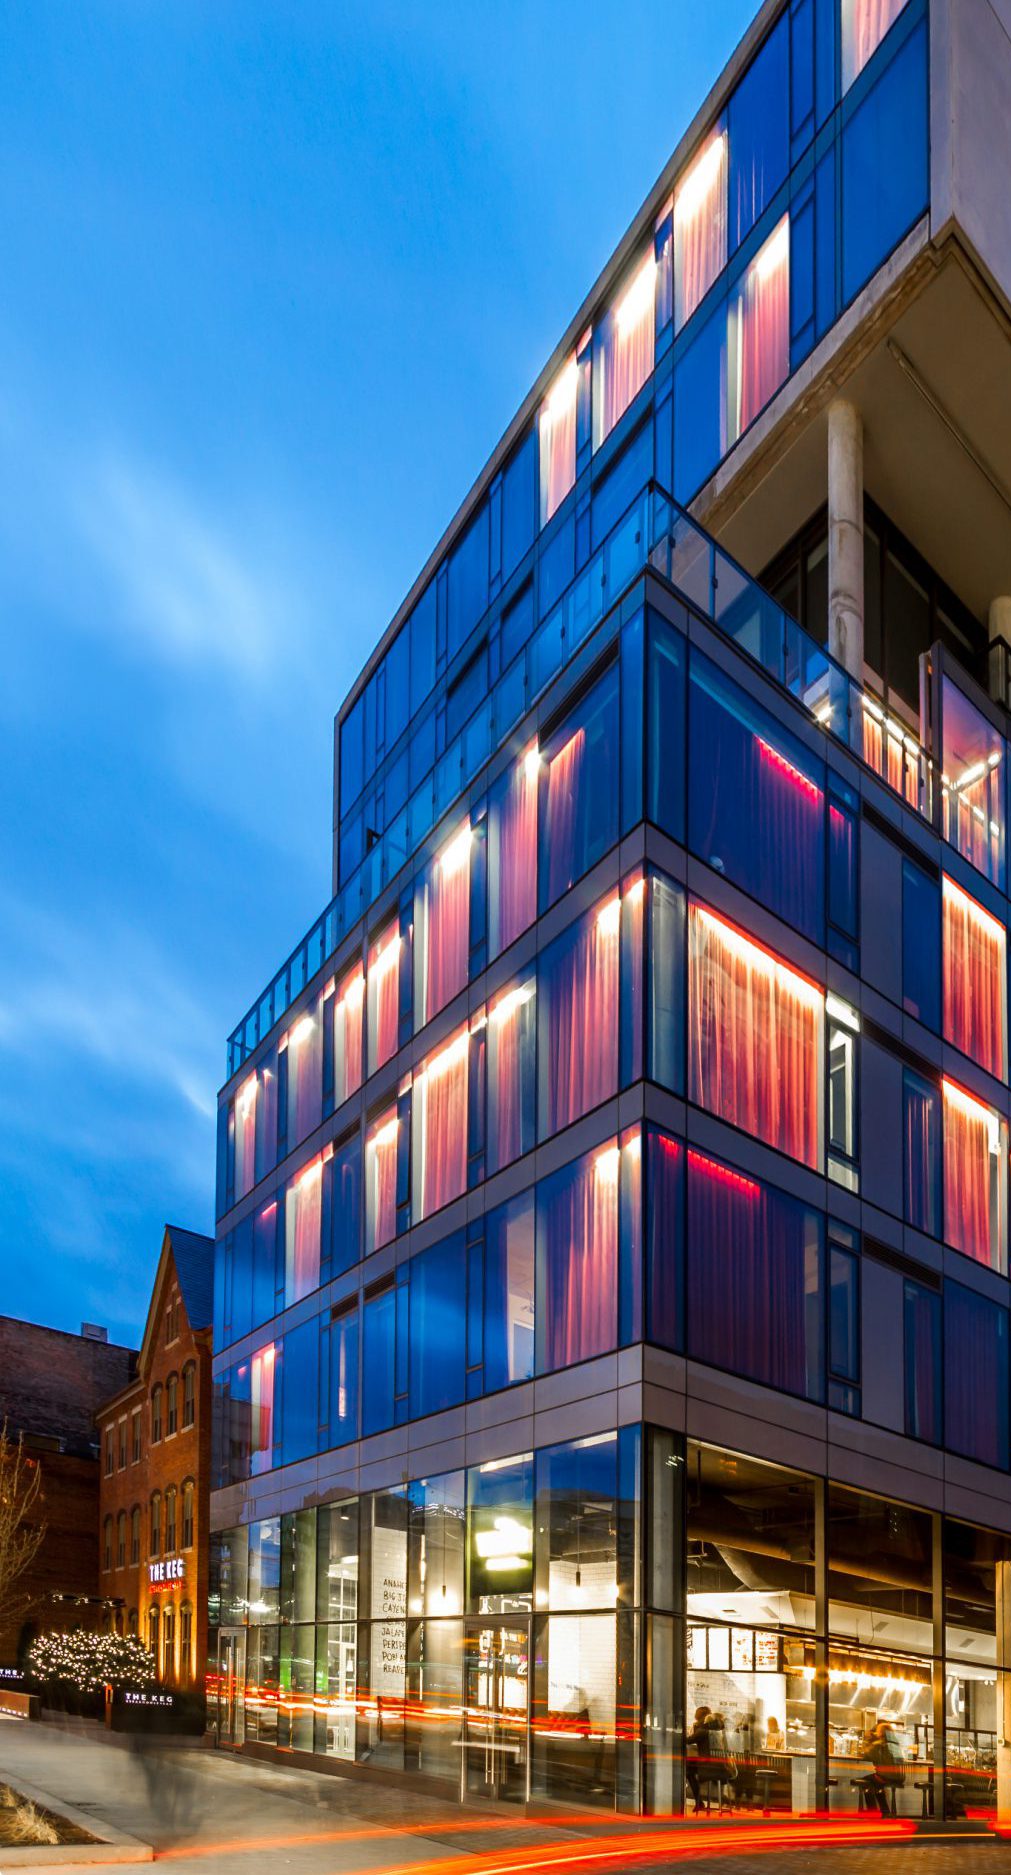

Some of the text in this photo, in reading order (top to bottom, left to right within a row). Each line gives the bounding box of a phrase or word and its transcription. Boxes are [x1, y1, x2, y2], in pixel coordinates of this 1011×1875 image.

[150, 1559, 184, 1582] THE KEG
[383, 1591, 396, 1601] BIG
[125, 1693, 147, 1701] THE
